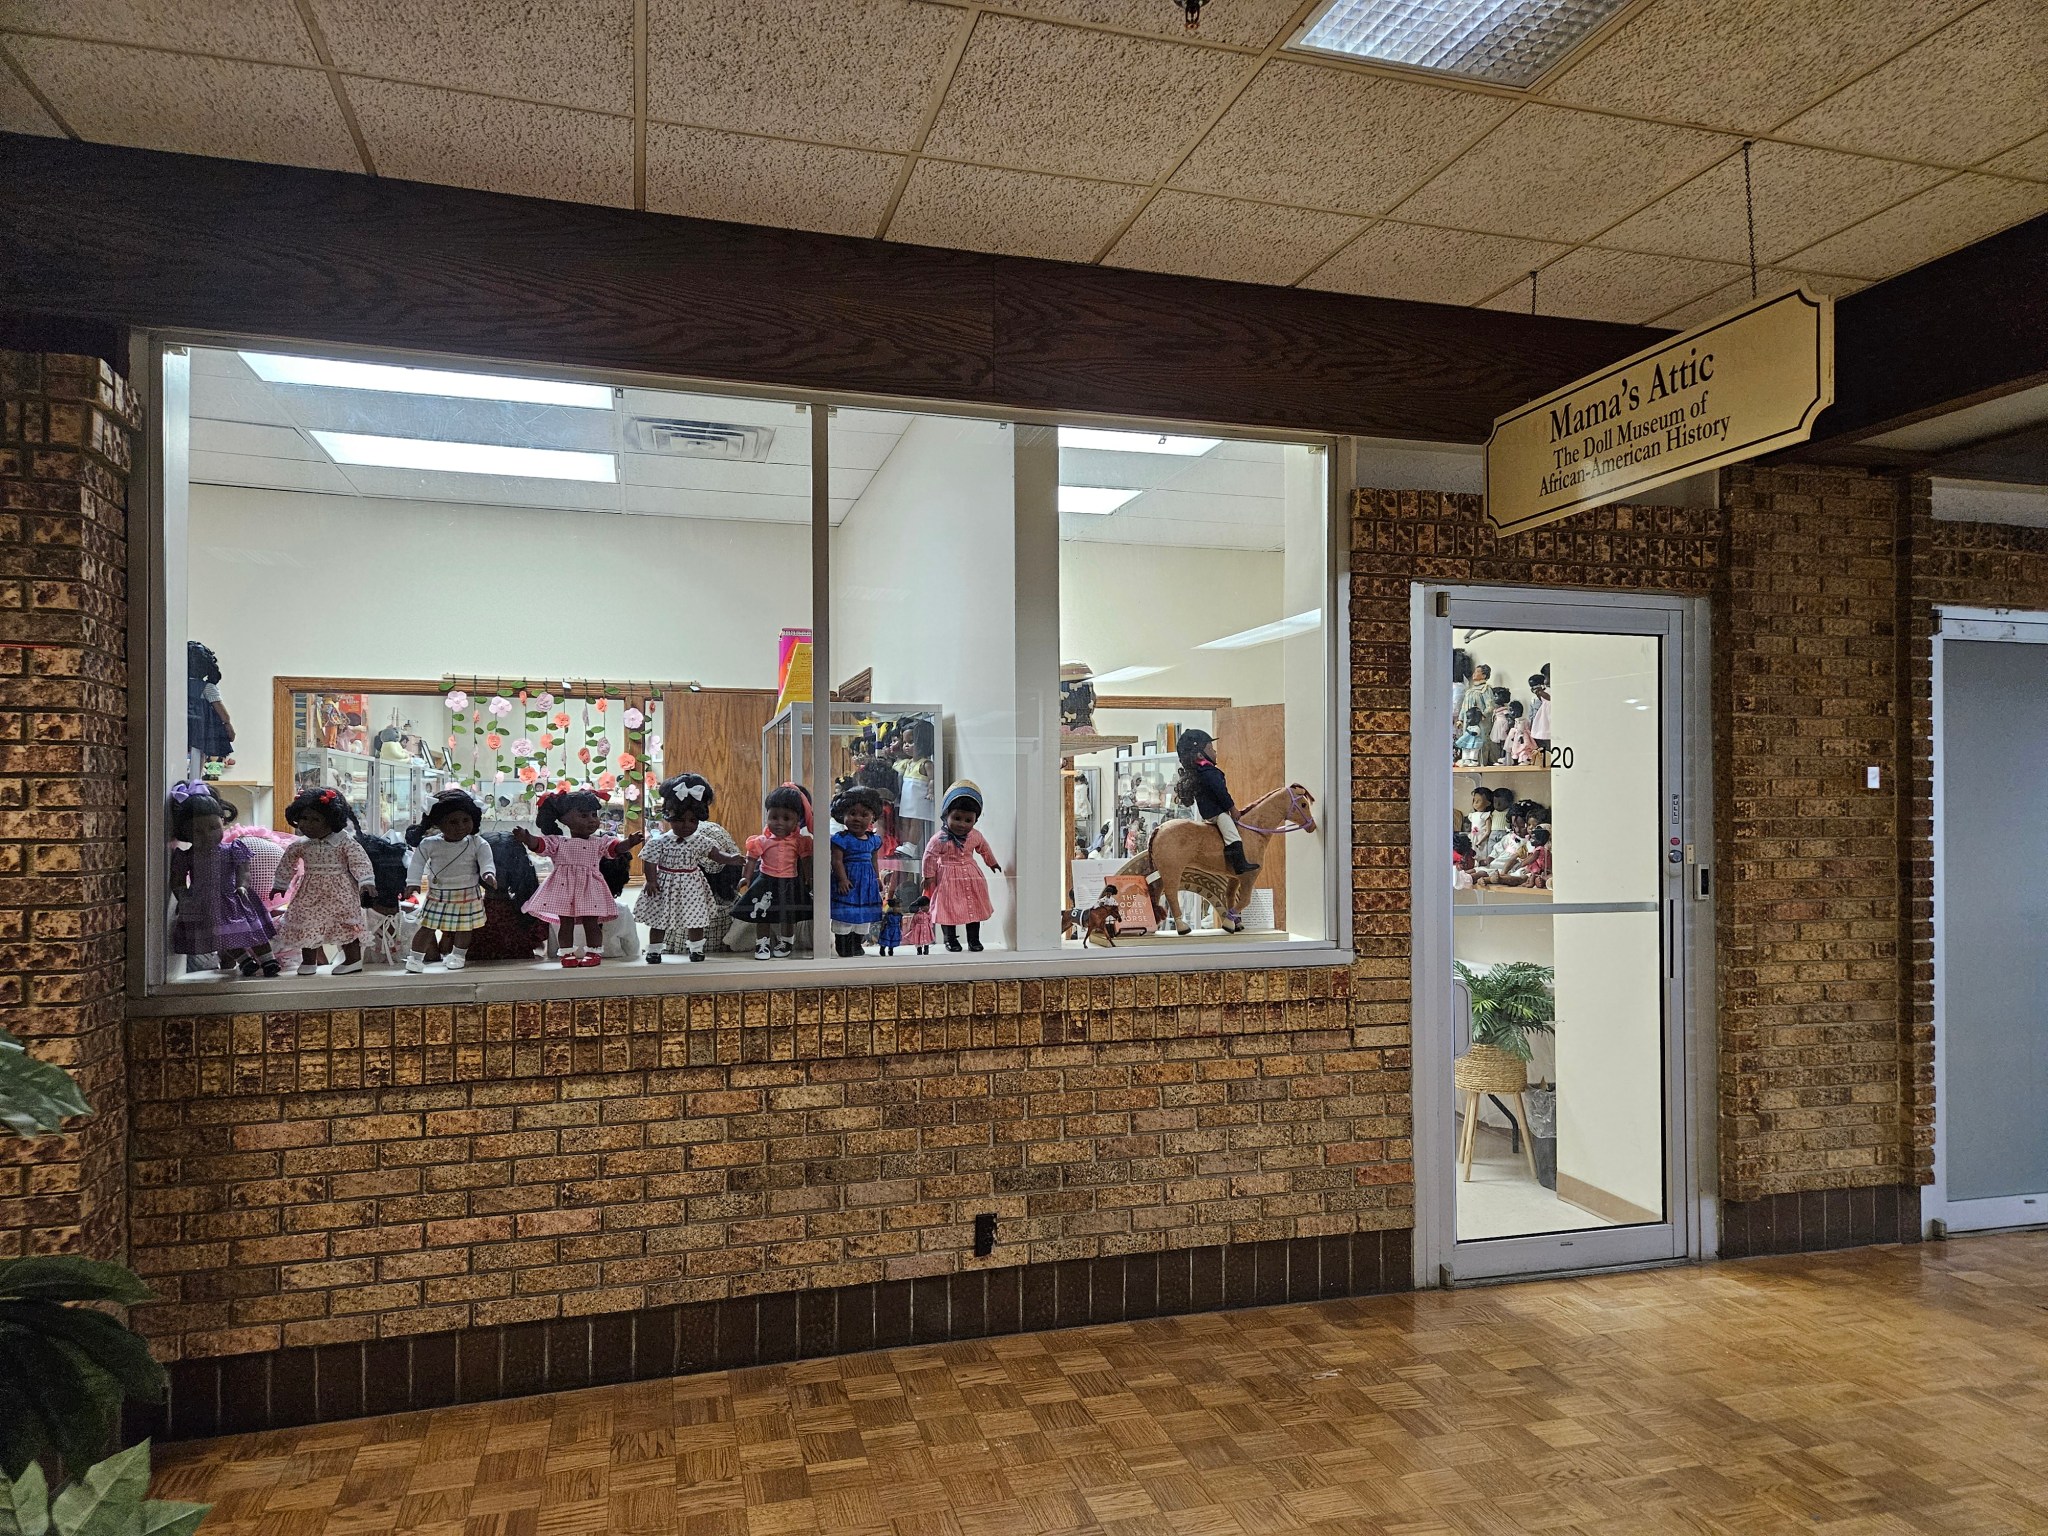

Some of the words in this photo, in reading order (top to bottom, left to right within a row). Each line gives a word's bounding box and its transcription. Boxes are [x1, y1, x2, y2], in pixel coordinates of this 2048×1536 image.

[1550, 378, 1640, 444] Mama's
[1646, 346, 1715, 404] Attic
[1553, 446, 1580, 470] The
[1583, 427, 1614, 460] Doll
[1617, 406, 1685, 447] Museum
[1690, 390, 1709, 419] of
[1538, 440, 1662, 497] African-American
[1665, 415, 1731, 453] History
[1540, 746, 1574, 769] 120
